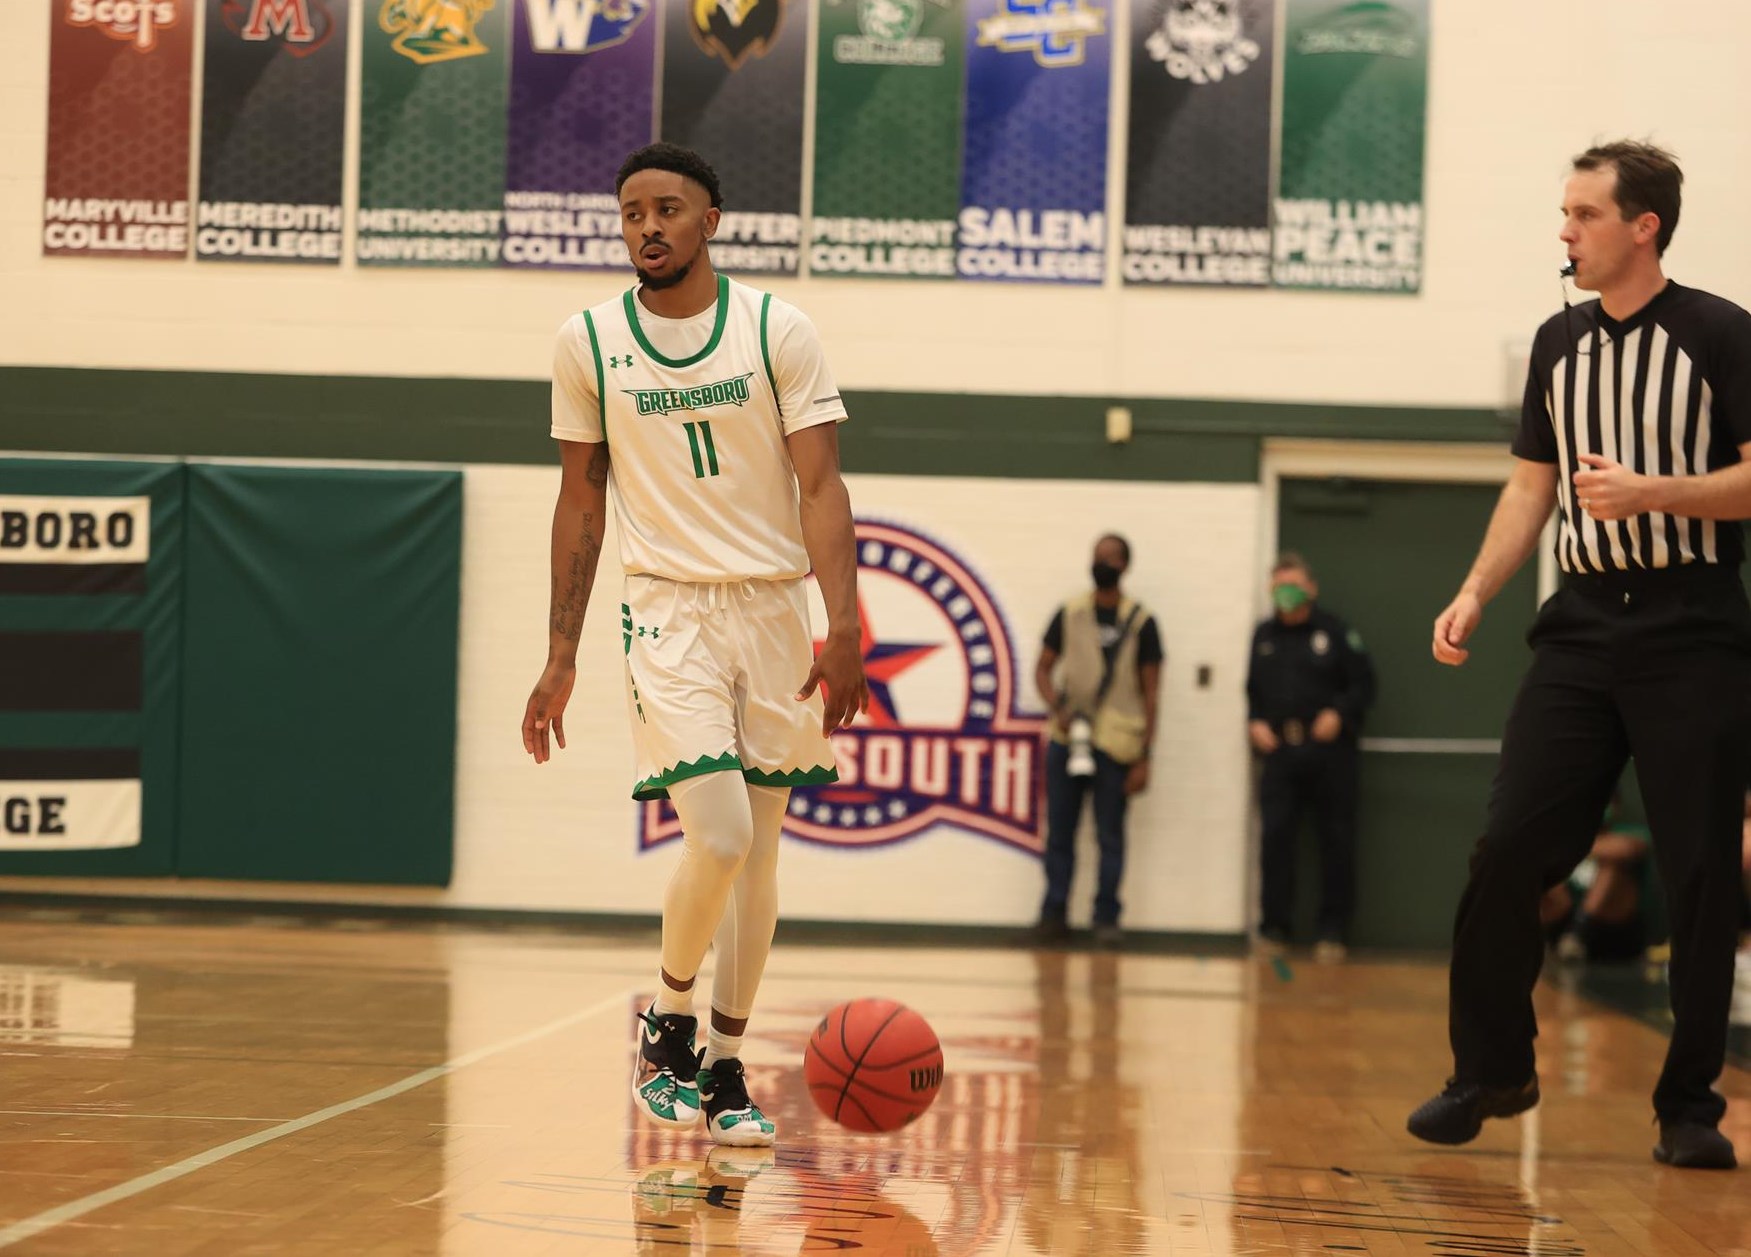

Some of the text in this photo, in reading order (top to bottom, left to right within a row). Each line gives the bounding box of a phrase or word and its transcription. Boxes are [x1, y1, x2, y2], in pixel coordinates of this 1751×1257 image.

[46, 198, 188, 224] MARYVILLE
[199, 202, 342, 230] MEREDITH
[358, 208, 500, 233] METHODIST
[505, 210, 622, 237] WESLEYA
[1273, 198, 1421, 227] WILLIAM
[45, 224, 187, 251] COLLEGE
[812, 216, 956, 248] PIEDMONT
[958, 206, 1105, 249] SALEM
[1124, 225, 1269, 253] WESLEYAN
[197, 229, 340, 257] COLLEGE
[357, 236, 500, 261] UNIVERSITY
[503, 236, 629, 266] COLLEG
[1274, 226, 1420, 266] PEACE
[811, 245, 955, 275] COLLEGE
[957, 248, 1103, 281] COLLEGE
[1124, 253, 1269, 283] COLLEGE
[1272, 263, 1419, 288] UNIVERSITY
[635, 376, 748, 414] GREENSBORO
[682, 420, 719, 478] 11
[0, 511, 134, 549] BORO
[862, 539, 997, 719] ONFERENCE
[832, 735, 1032, 822] SOUTH
